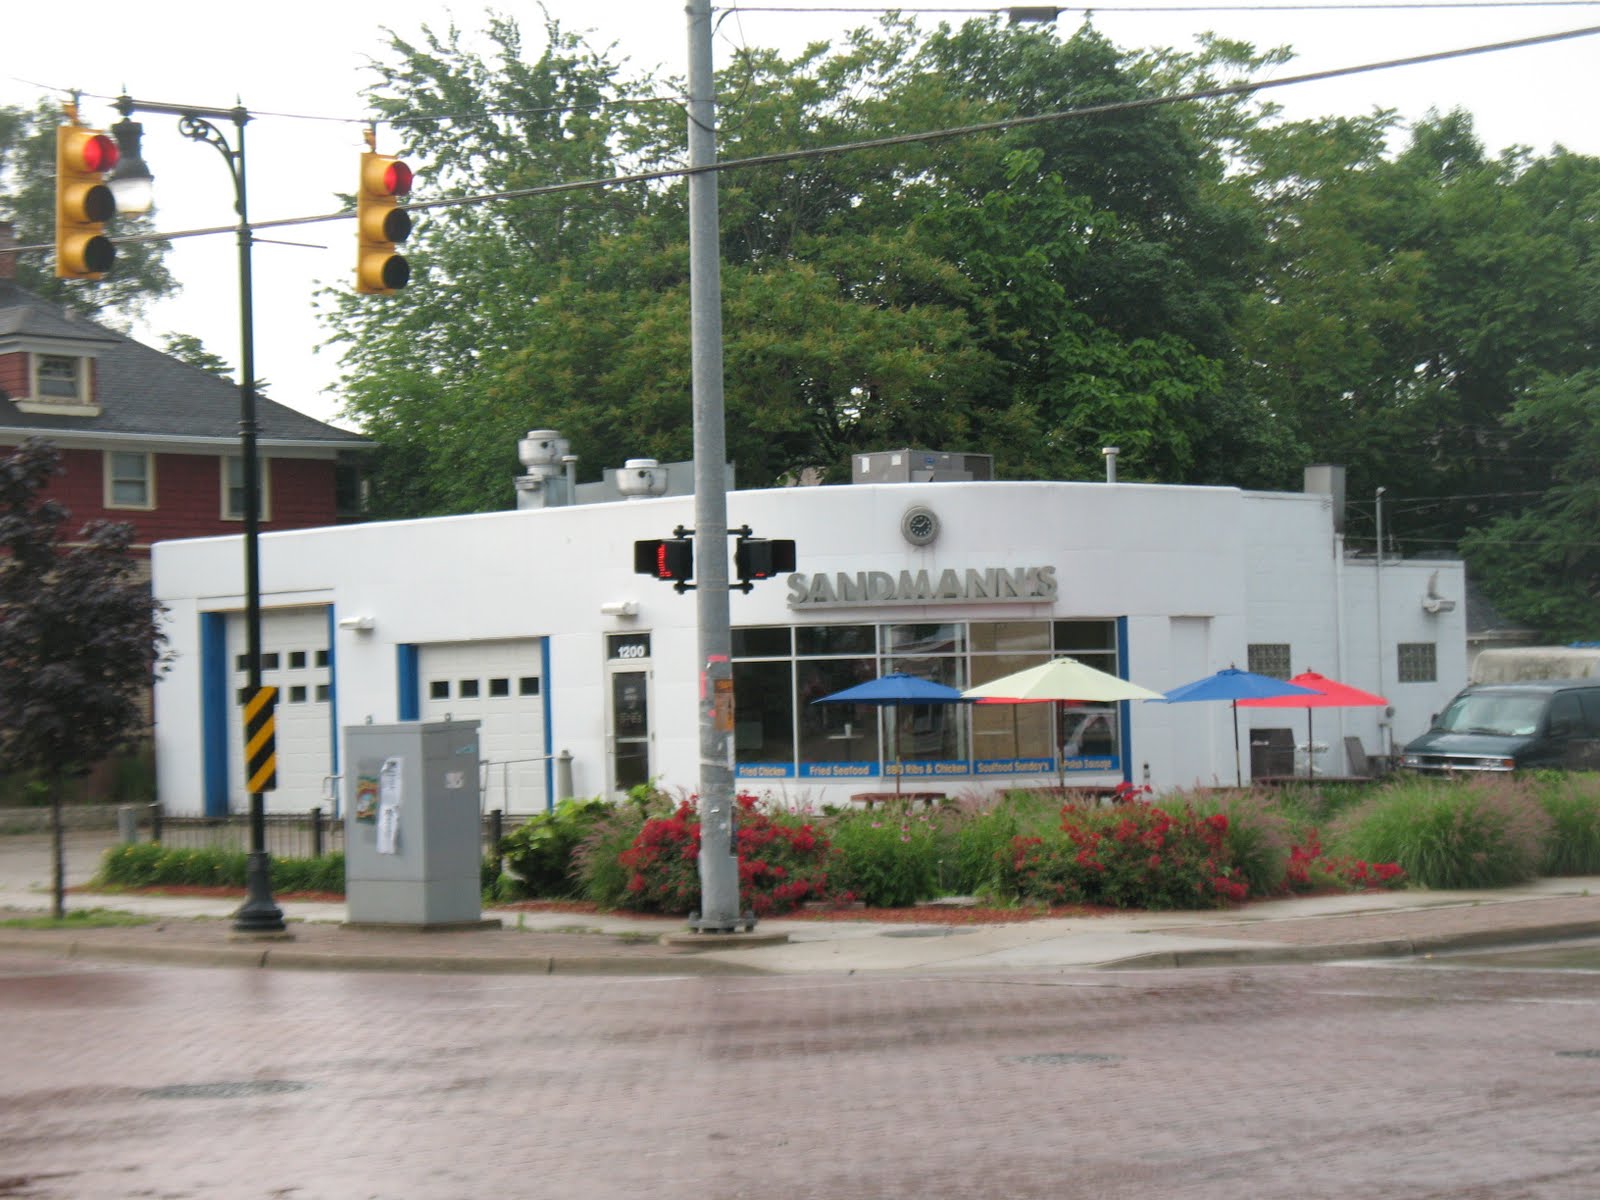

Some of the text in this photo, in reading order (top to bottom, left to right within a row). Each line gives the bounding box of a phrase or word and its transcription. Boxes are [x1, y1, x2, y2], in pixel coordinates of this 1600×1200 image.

[786, 565, 1058, 604] SANDMANN'S
[618, 645, 645, 658] 1200
[809, 764, 870, 776] Fried Seafood
[935, 763, 968, 774] Chicken
